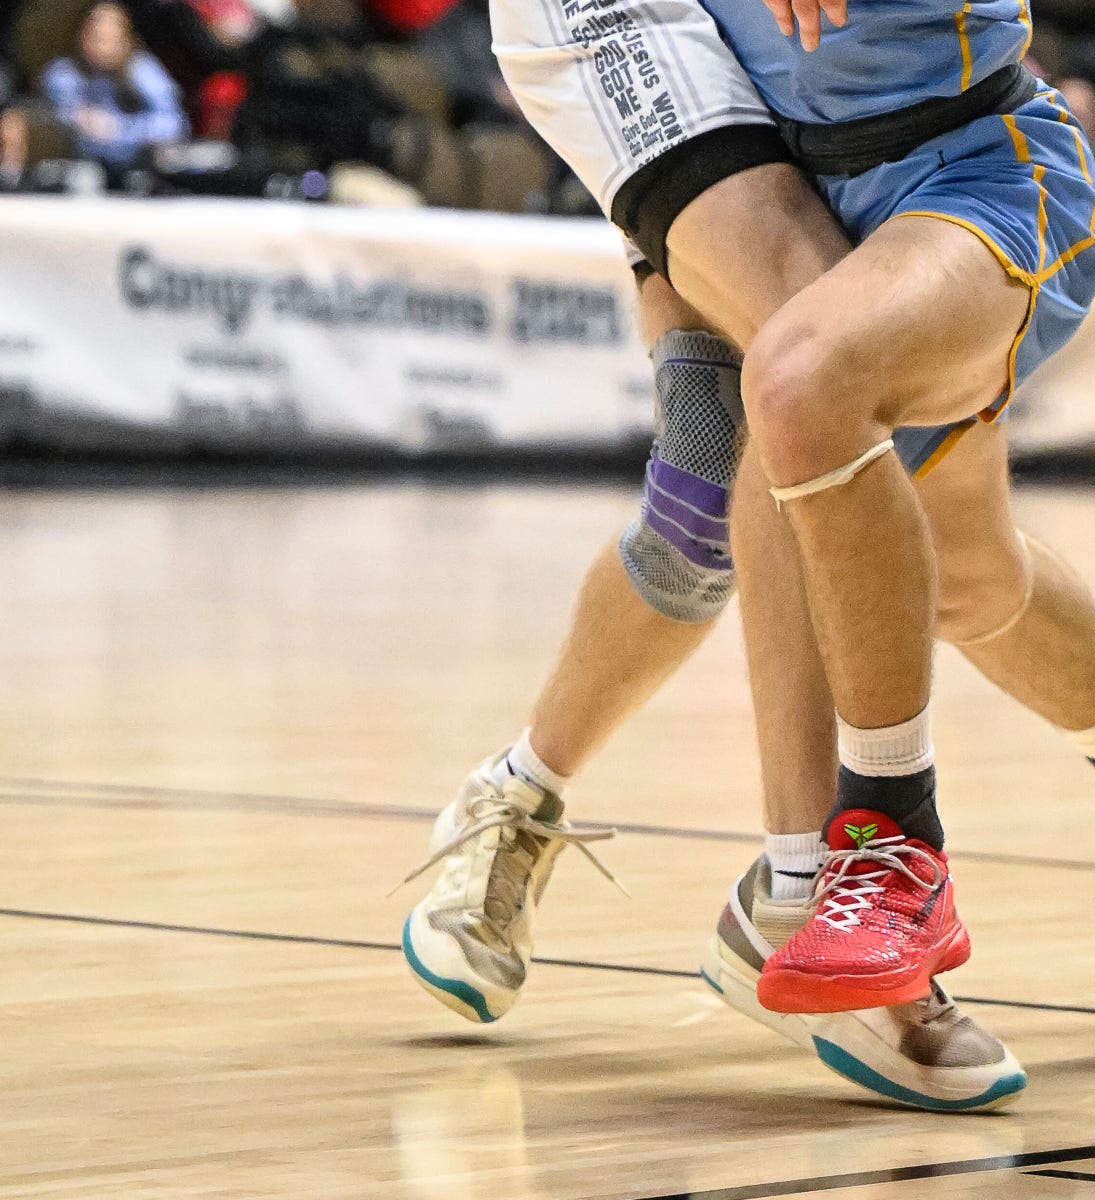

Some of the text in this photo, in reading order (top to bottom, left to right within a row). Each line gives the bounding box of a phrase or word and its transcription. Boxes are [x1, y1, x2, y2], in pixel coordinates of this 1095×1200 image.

[594, 39, 626, 75] GOD
[600, 61, 634, 99] GOT
[622, 31, 660, 89] JESUS
[652, 91, 683, 141] WON
[614, 87, 642, 120] ME
[639, 109, 658, 131] God
